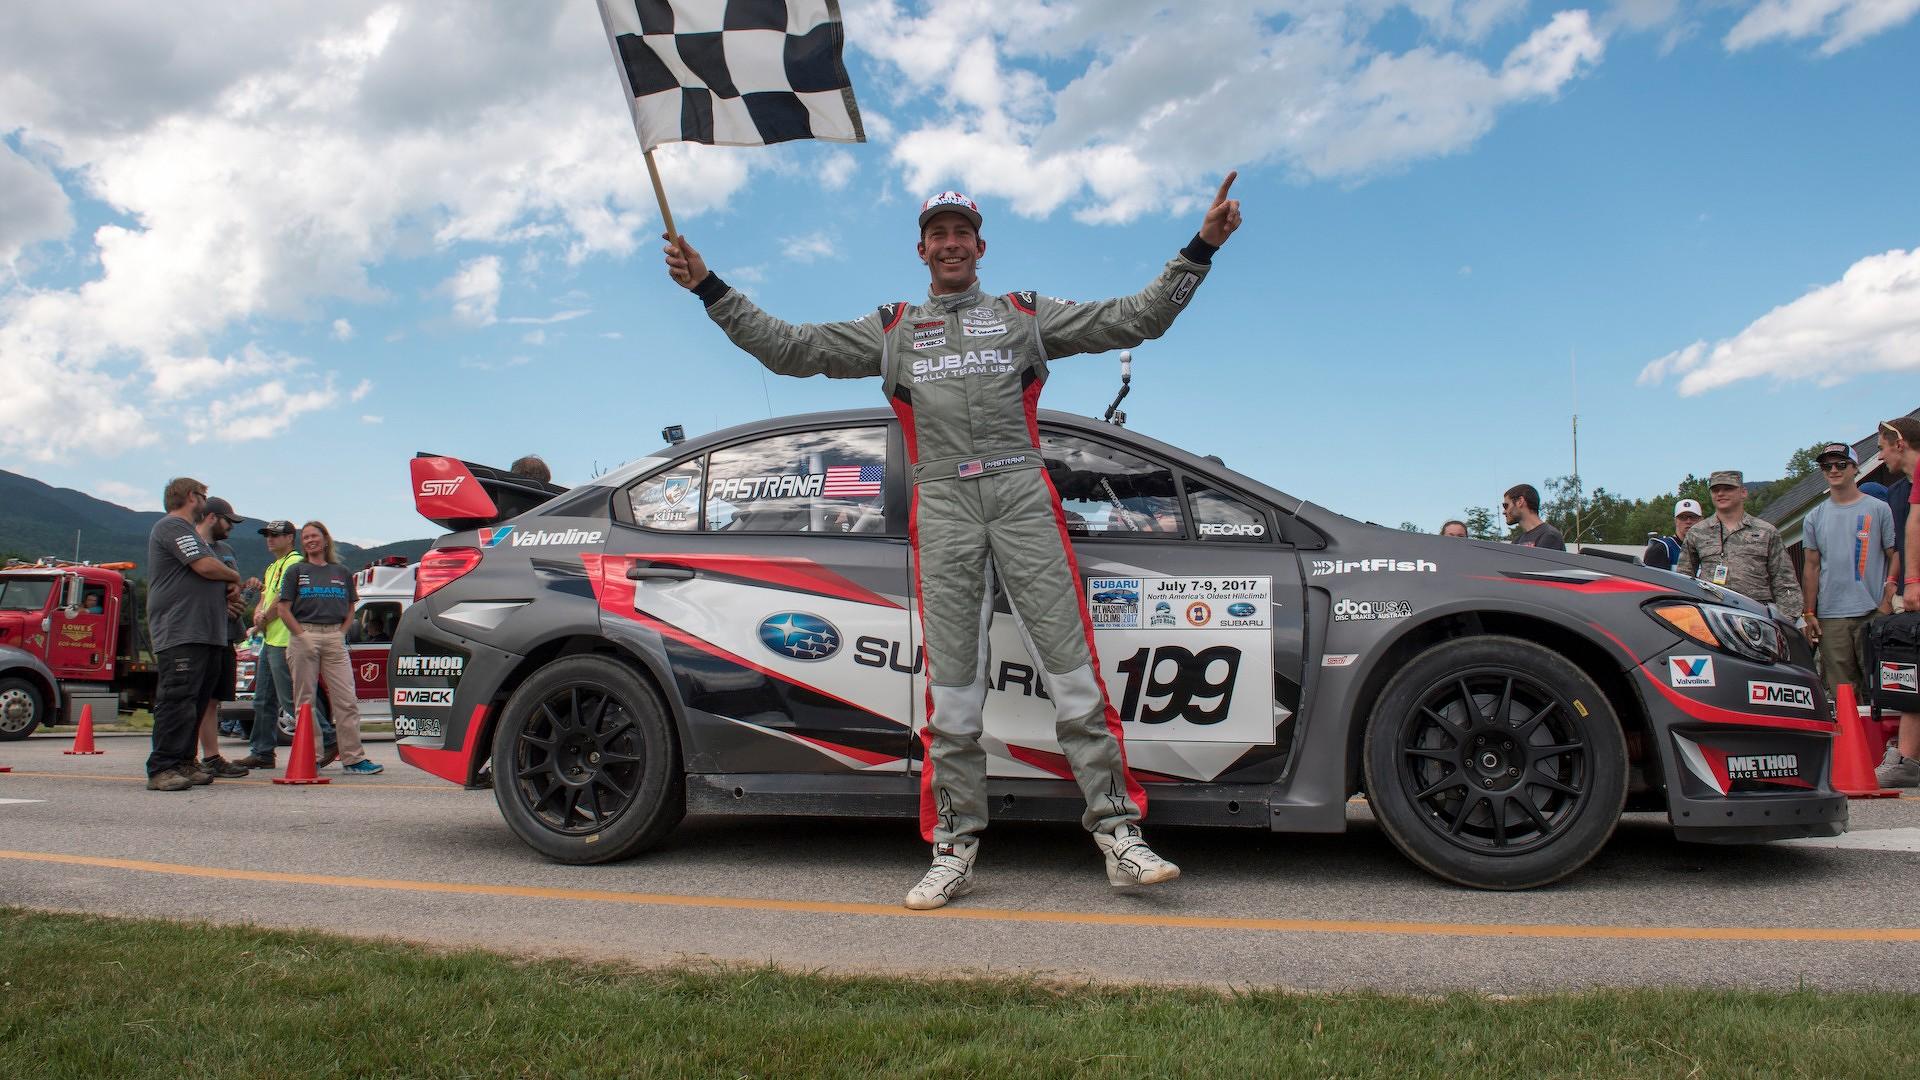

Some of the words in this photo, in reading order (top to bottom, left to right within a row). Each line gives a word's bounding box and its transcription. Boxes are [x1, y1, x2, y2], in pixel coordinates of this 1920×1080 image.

[962, 318, 1002, 326] SUBARU
[912, 349, 1013, 376] SUBARU
[913, 371, 948, 384] RALLY
[951, 366, 987, 376] TEAM
[990, 365, 1015, 373] USA
[984, 455, 1025, 469] PASTRANA
[707, 474, 825, 500] PASTRANA
[1199, 523, 1265, 537] RECARO
[511, 529, 602, 547] Valvoline
[1312, 559, 1437, 576] DirtFish
[1093, 580, 1139, 589] SUBARU
[1157, 581, 1187, 593] July
[1191, 580, 1217, 592] 7-9,
[1222, 580, 1257, 590] 2017
[1232, 592, 1268, 600] Hillclimb!
[1102, 603, 1139, 614] WASHINGTON
[1378, 611, 1413, 619] AUSTRALIA
[1123, 613, 1138, 623] 2017
[398, 656, 463, 669] METHOD
[1882, 671, 1915, 683] CHAMPION
[1116, 645, 1242, 725] 199
[1727, 754, 1798, 772] METHOD
[1729, 771, 1758, 779] RACE
[1762, 768, 1799, 778] WHEELS
